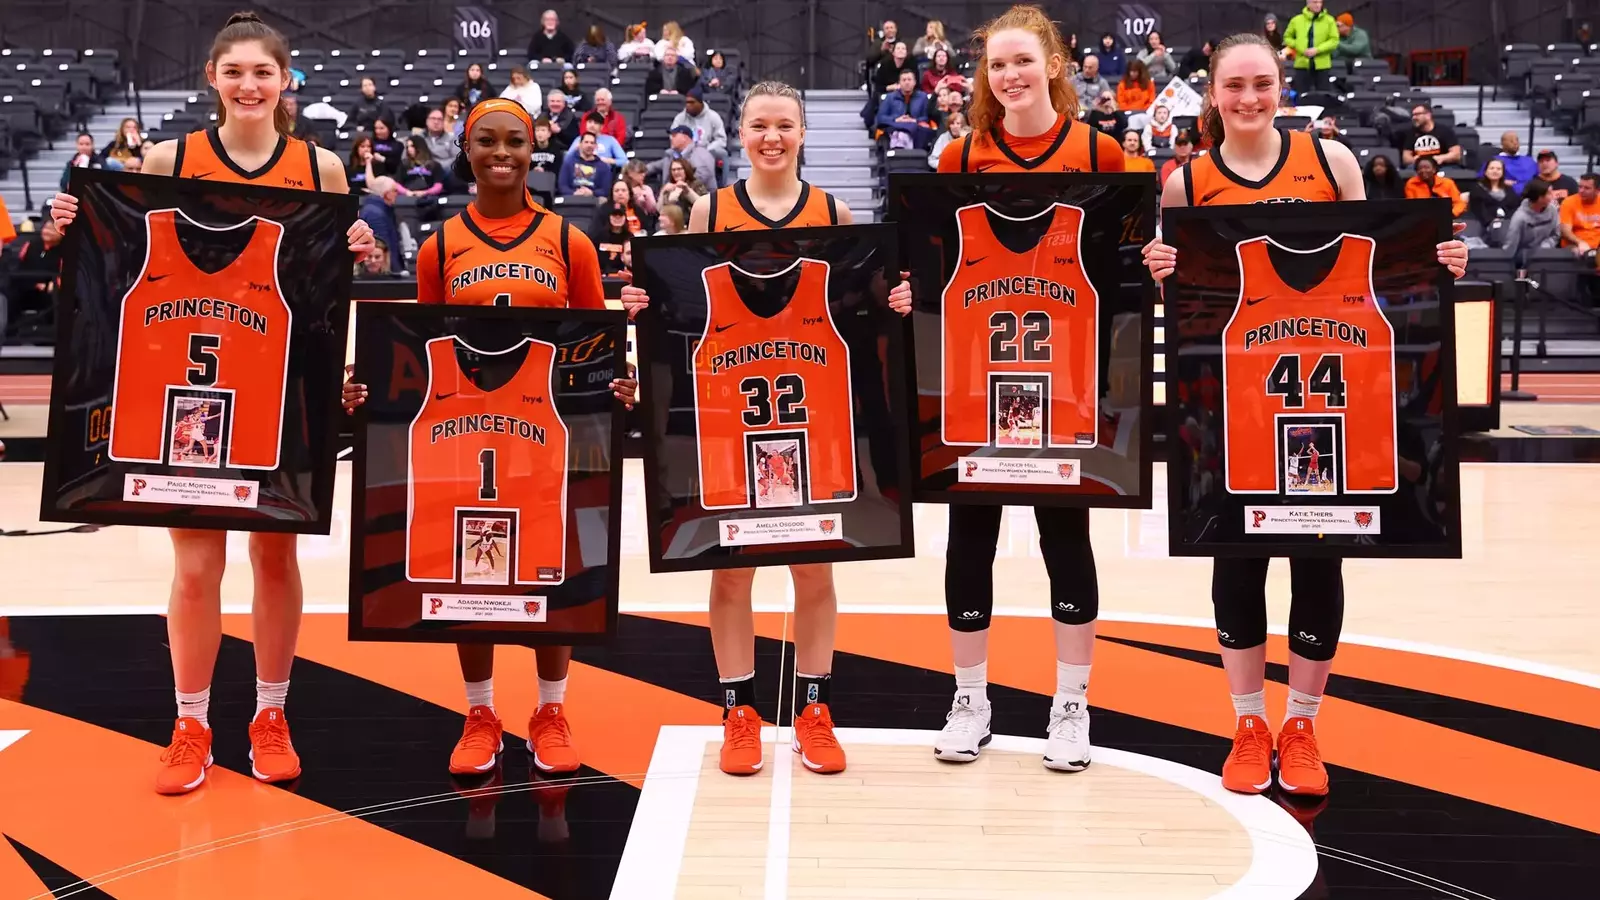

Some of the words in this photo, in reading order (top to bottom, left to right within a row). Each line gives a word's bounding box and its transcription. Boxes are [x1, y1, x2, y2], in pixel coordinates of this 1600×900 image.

[460, 20, 491, 38] 106
[1123, 18, 1156, 35] 107
[284, 177, 297, 187] Ivy
[1054, 256, 1067, 264] Ivy
[451, 262, 558, 297] PRINCETON
[963, 276, 1076, 309] PRINCETON
[1343, 295, 1358, 304] Ivy
[144, 298, 267, 335] PRINCETON
[802, 316, 816, 325] Ivy
[988, 310, 1052, 363] 22
[1244, 317, 1368, 351] PRINCETON
[185, 333, 221, 388] 5
[711, 340, 827, 375] PRINCETON
[1265, 353, 1347, 409] 44
[522, 394, 536, 404] Ivy
[739, 372, 809, 427] 32
[430, 414, 546, 446] PRINCETON
[167, 480, 187, 488] PAIGE
[188, 482, 217, 490] MORTON
[478, 448, 497, 501] 1
